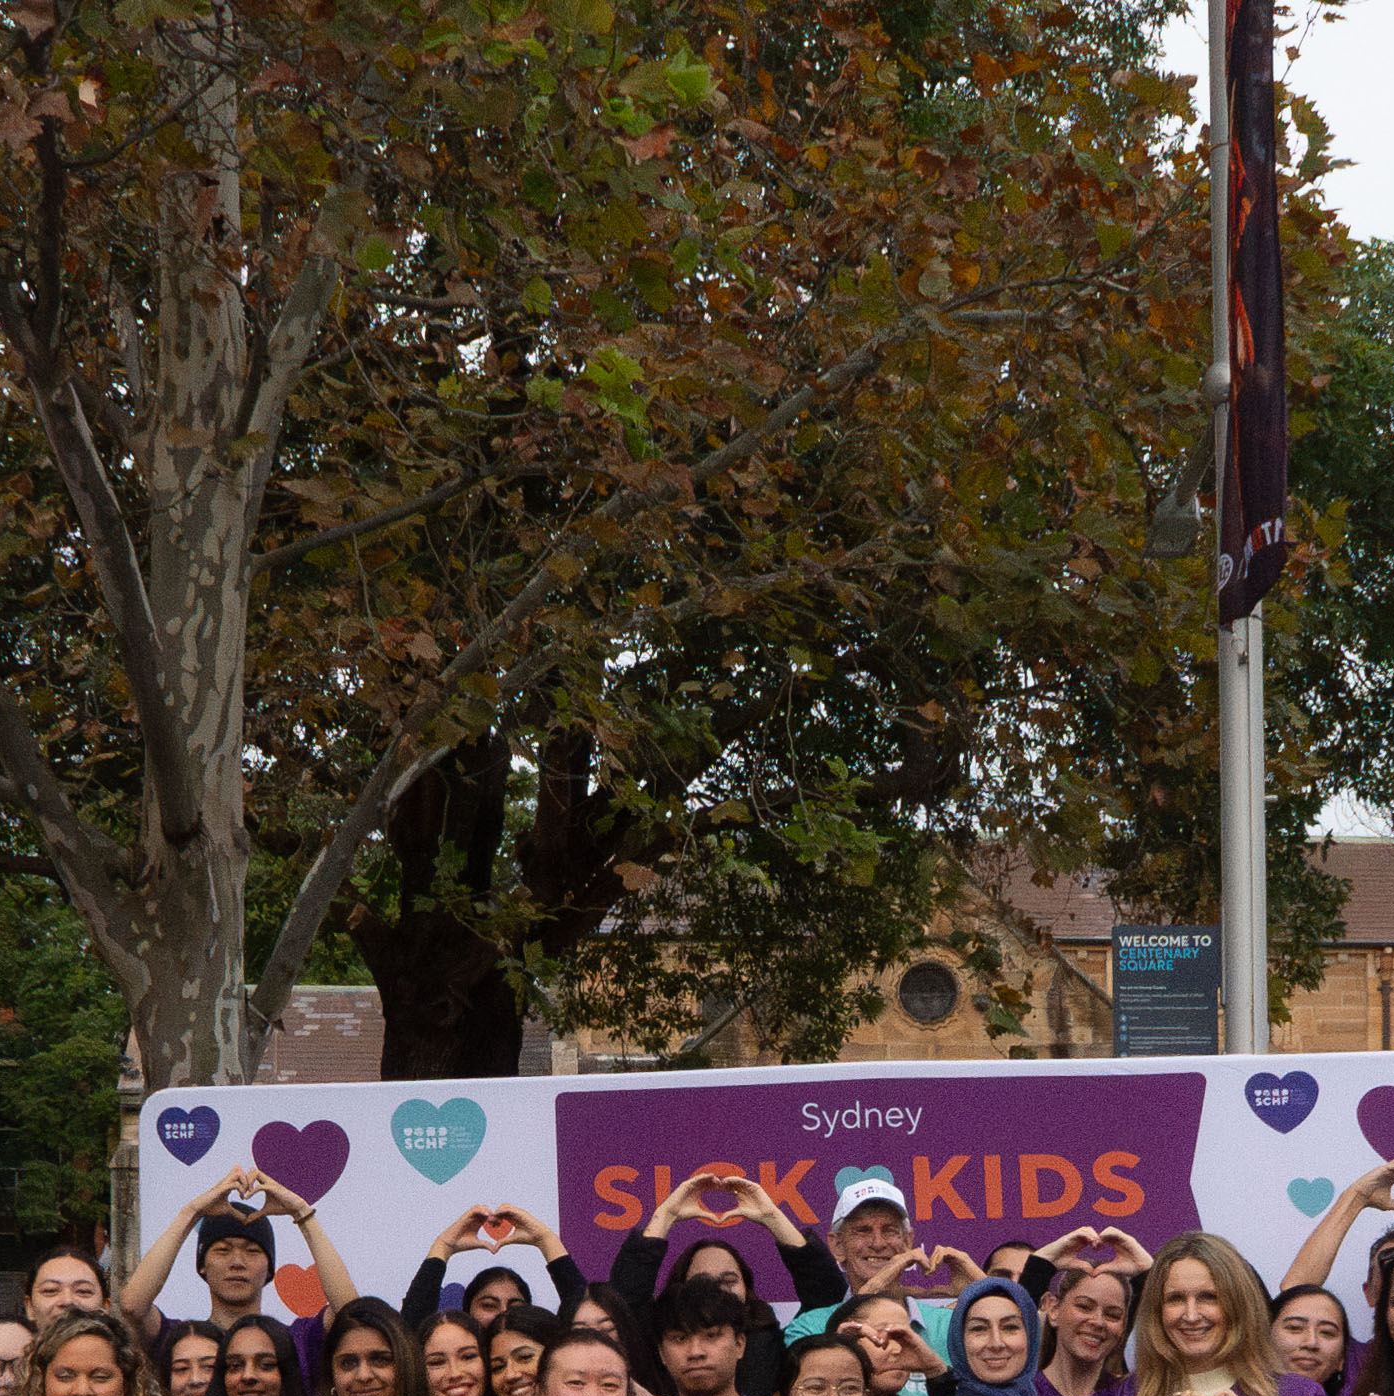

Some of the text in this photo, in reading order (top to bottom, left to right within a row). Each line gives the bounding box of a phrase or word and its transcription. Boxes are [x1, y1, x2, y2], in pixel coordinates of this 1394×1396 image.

[1118, 935, 1212, 947] WELCOME TO
[1119, 948, 1200, 959] CENTENARY
[1119, 960, 1174, 971] SQUARE
[1255, 1095, 1291, 1107] SCHF
[801, 1102, 924, 1138] Sydney
[165, 1130, 195, 1140] SCHF
[404, 1137, 449, 1150] SCHF
[912, 1151, 1146, 1221] KIDS
